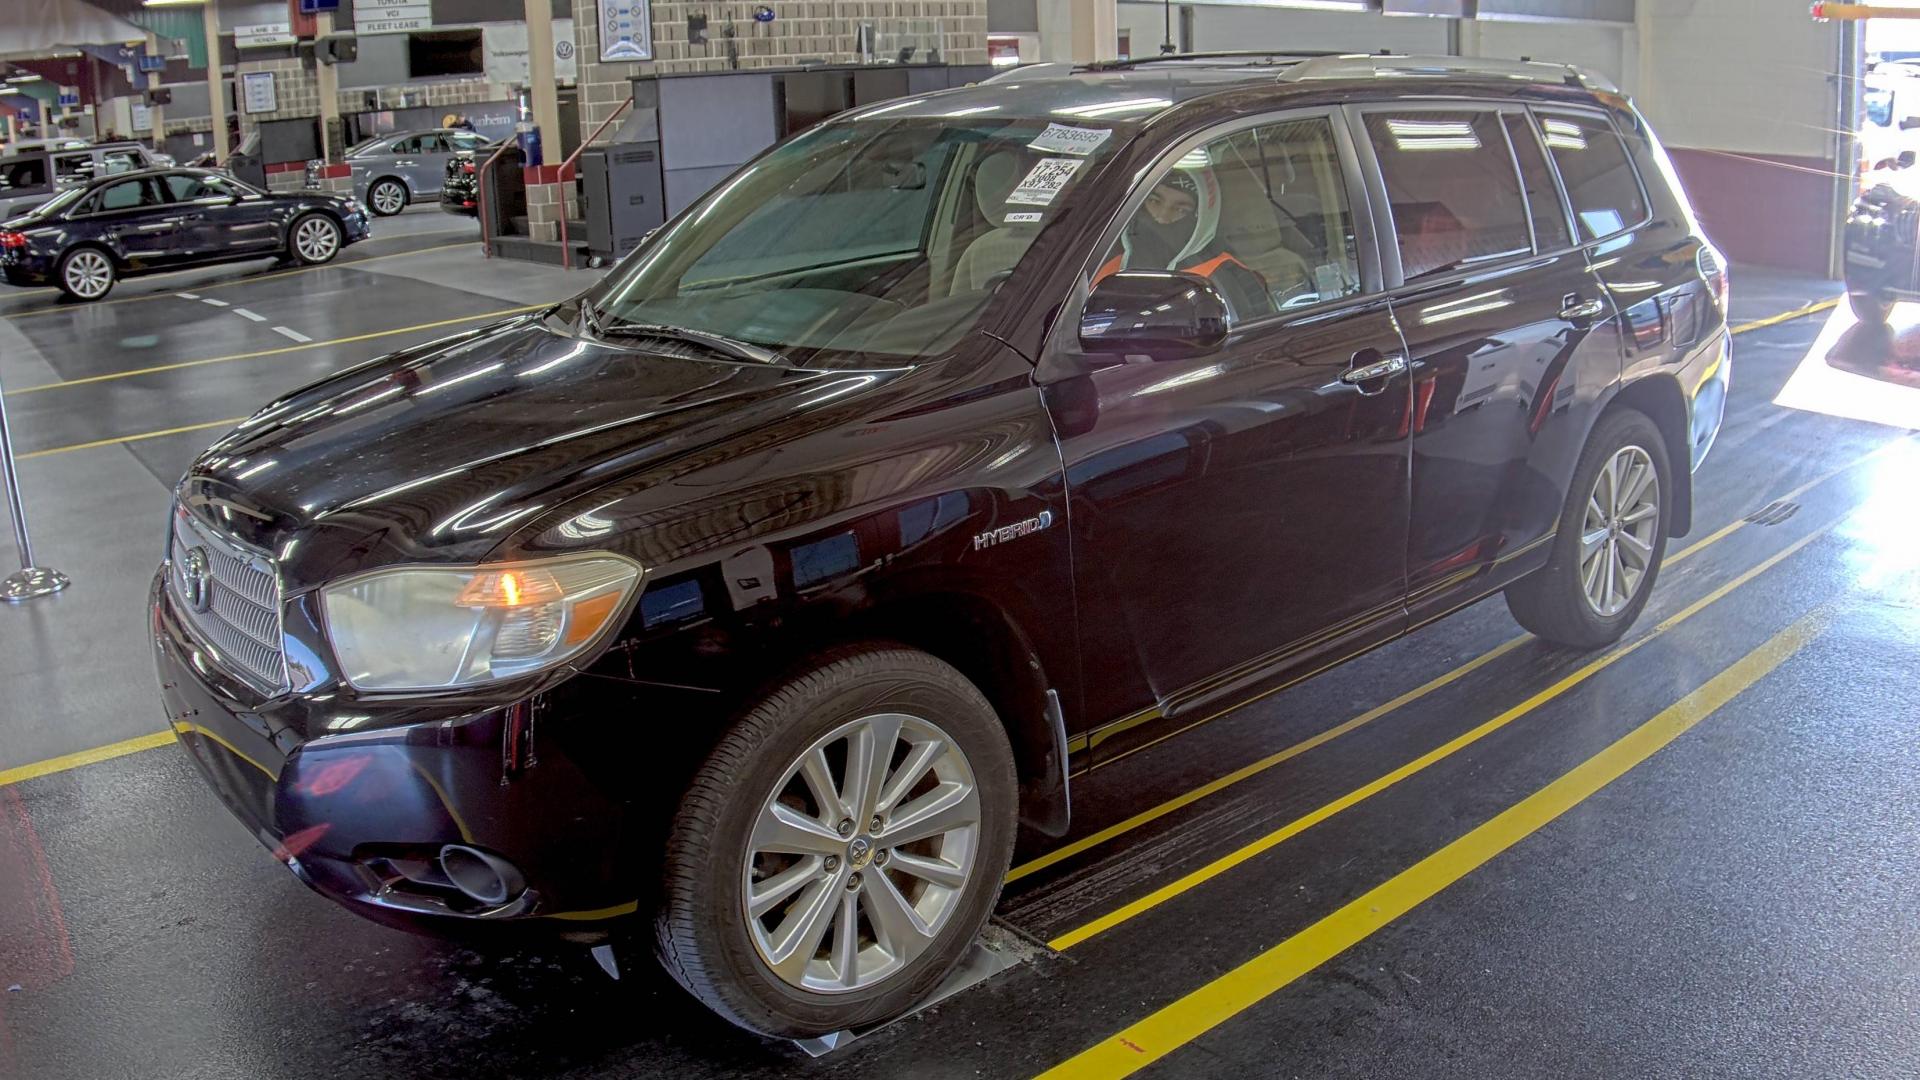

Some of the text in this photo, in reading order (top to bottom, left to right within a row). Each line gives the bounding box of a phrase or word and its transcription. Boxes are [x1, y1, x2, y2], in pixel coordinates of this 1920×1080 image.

[386, 9, 400, 17] VCI
[367, 20, 420, 31] FLEET LEASE
[973, 517, 1041, 551] HYBRID
